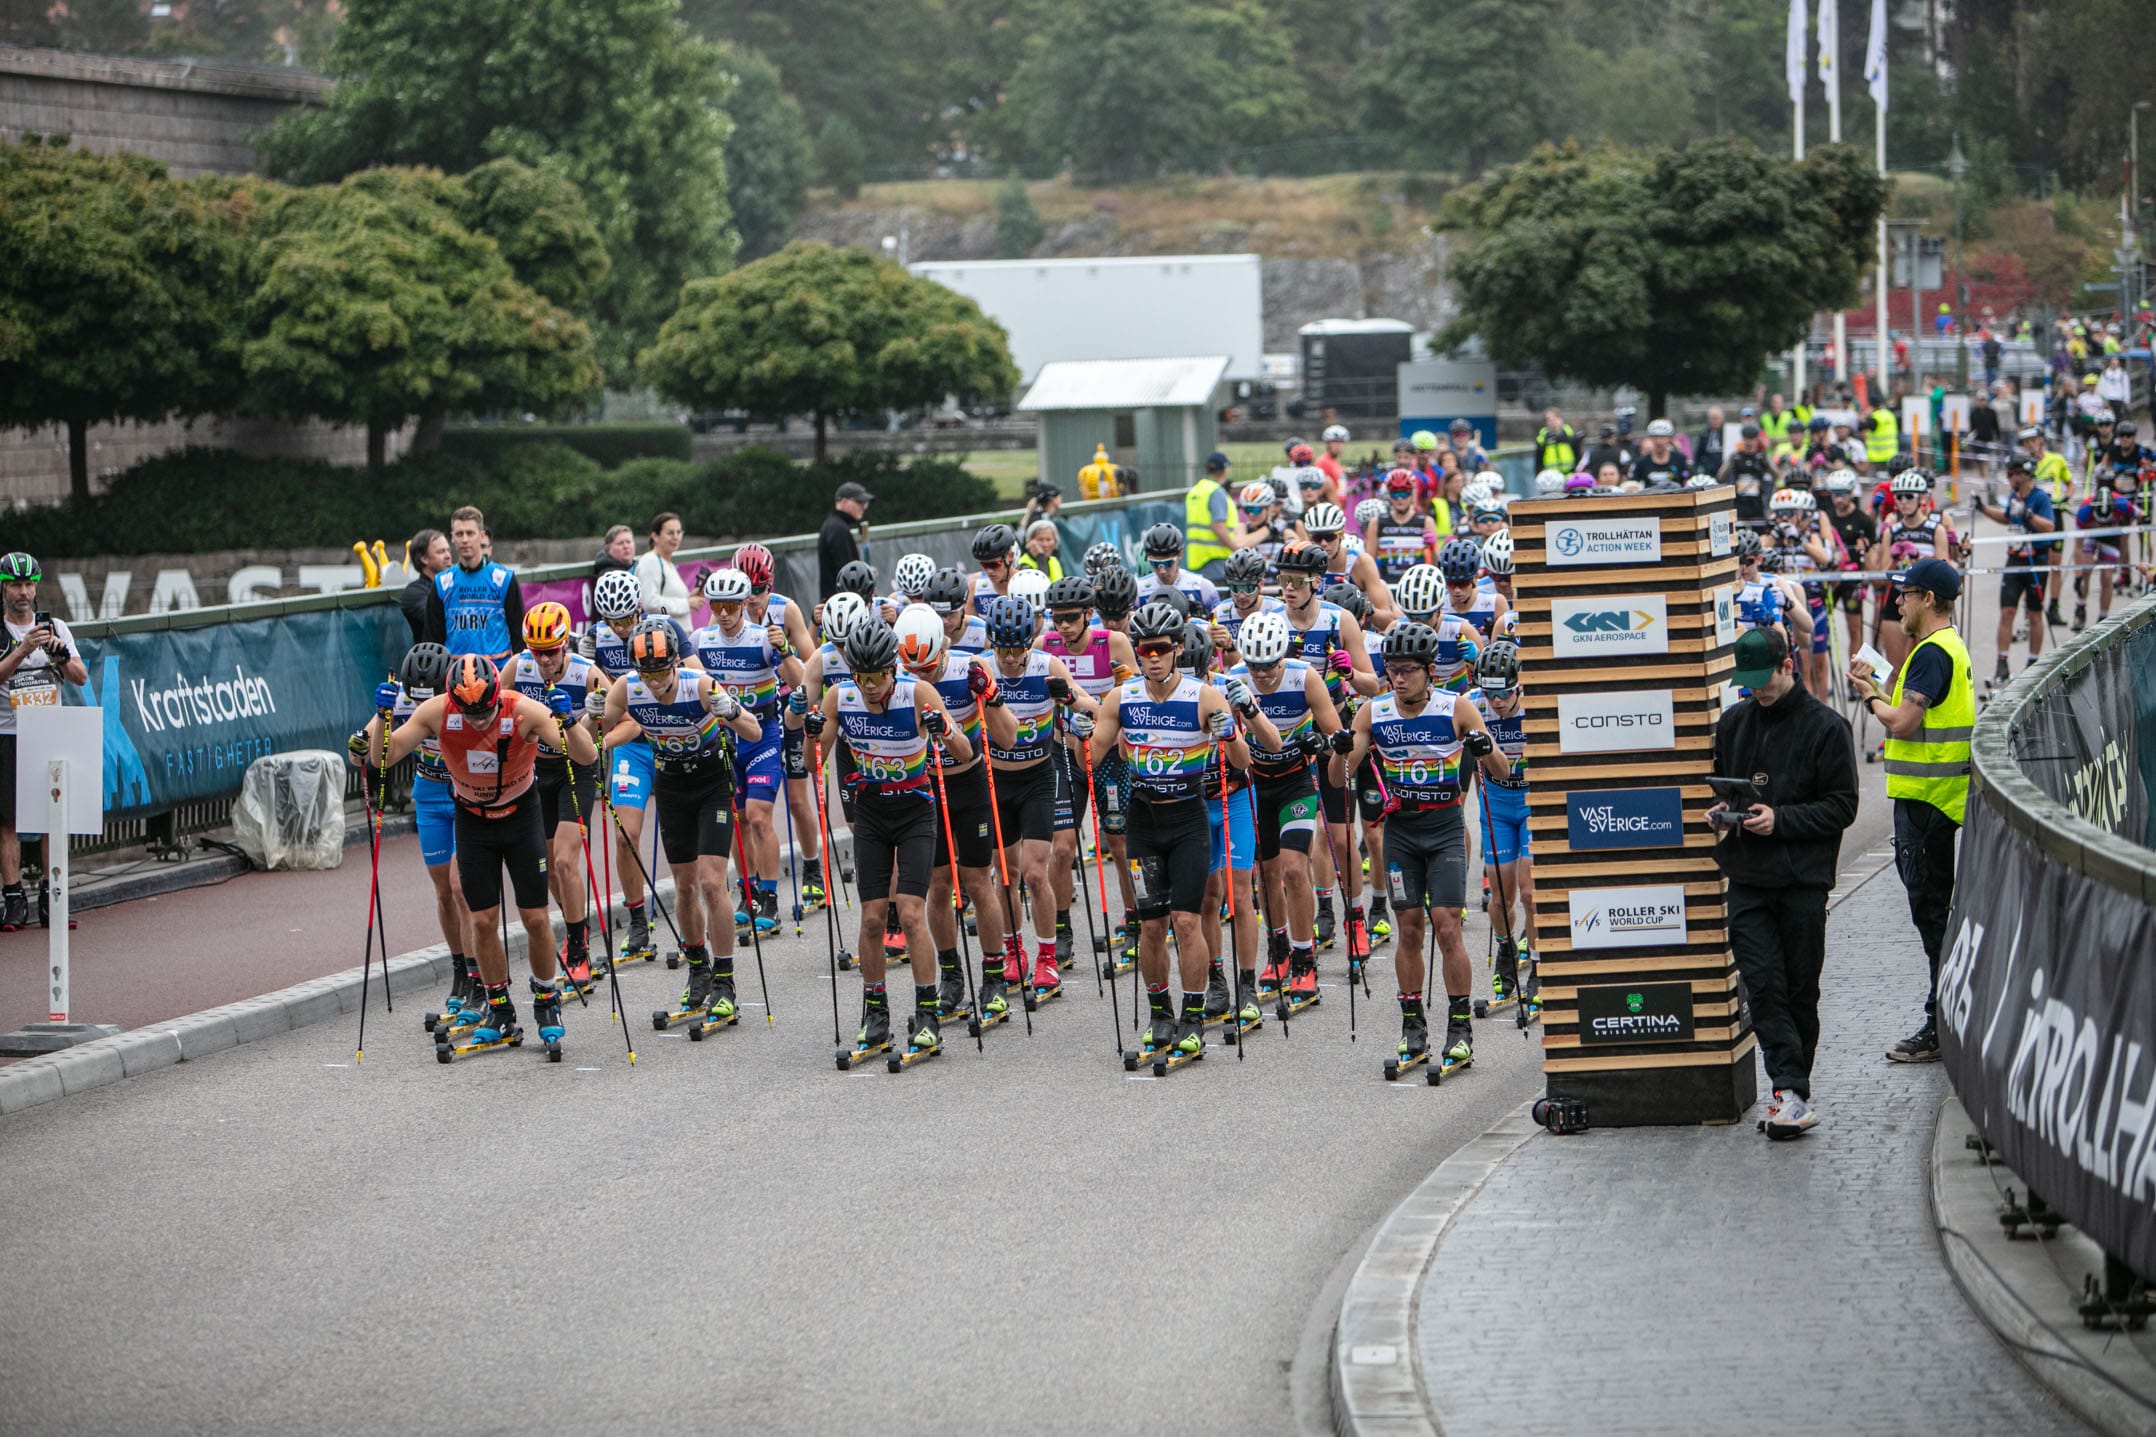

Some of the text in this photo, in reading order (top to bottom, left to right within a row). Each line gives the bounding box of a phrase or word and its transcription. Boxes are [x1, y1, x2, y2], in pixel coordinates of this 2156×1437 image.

[1586, 528, 1653, 541] TROLLHÄTTAN
[1586, 541, 1653, 553] ACTION WEEK
[453, 613, 488, 631] JURY
[1572, 631, 1647, 643] GKN AEROSPACE
[706, 651, 726, 661] VAST
[17, 691, 53, 706] 1332
[131, 664, 277, 733] Kraftstaden
[635, 707, 659, 718] VAST
[1128, 706, 1152, 717] VAST
[845, 715, 869, 728] VAST
[1131, 715, 1193, 729] SVERIGE.com
[849, 726, 911, 738] SVERIGE.com
[1380, 724, 1403, 736] VAST
[653, 733, 701, 753] 169
[1386, 731, 1450, 745] SVERIGE.com
[166, 737, 273, 777] FASTIGHETER
[990, 747, 1044, 760] CONSTO
[1132, 745, 1185, 776] 162
[857, 753, 908, 783] 163
[1395, 759, 1445, 785] 161
[1393, 788, 1451, 801] CONSTO
[1579, 806, 1614, 821] VAST
[1589, 816, 1673, 833] SVERIGE.com
[1608, 904, 1681, 918] ROLLER SKI
[1609, 915, 1664, 926] WORLD CUP
[1592, 1014, 1681, 1029] CERTINA
